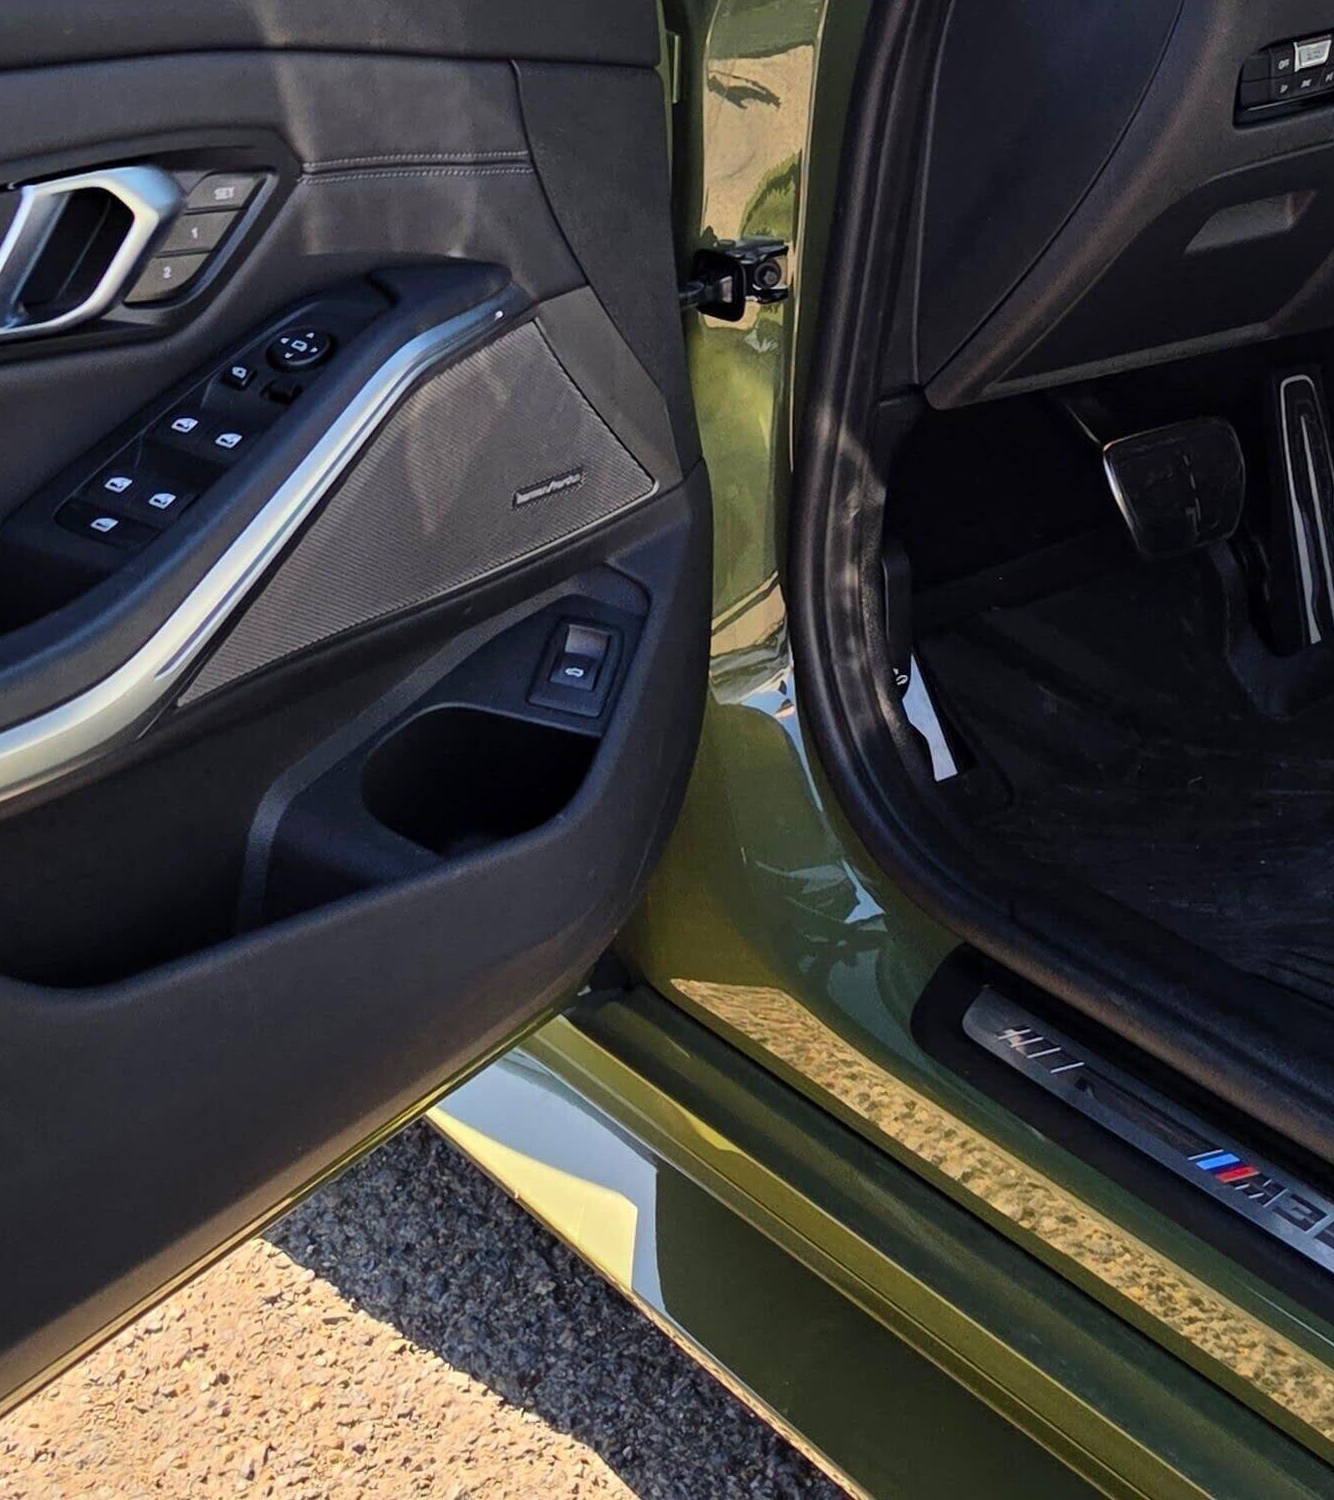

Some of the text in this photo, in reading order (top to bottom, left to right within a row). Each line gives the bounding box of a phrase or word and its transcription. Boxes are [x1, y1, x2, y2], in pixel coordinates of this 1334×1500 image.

[214, 187, 236, 200] SET
[191, 226, 198, 239] 1
[163, 266, 171, 279] 2
